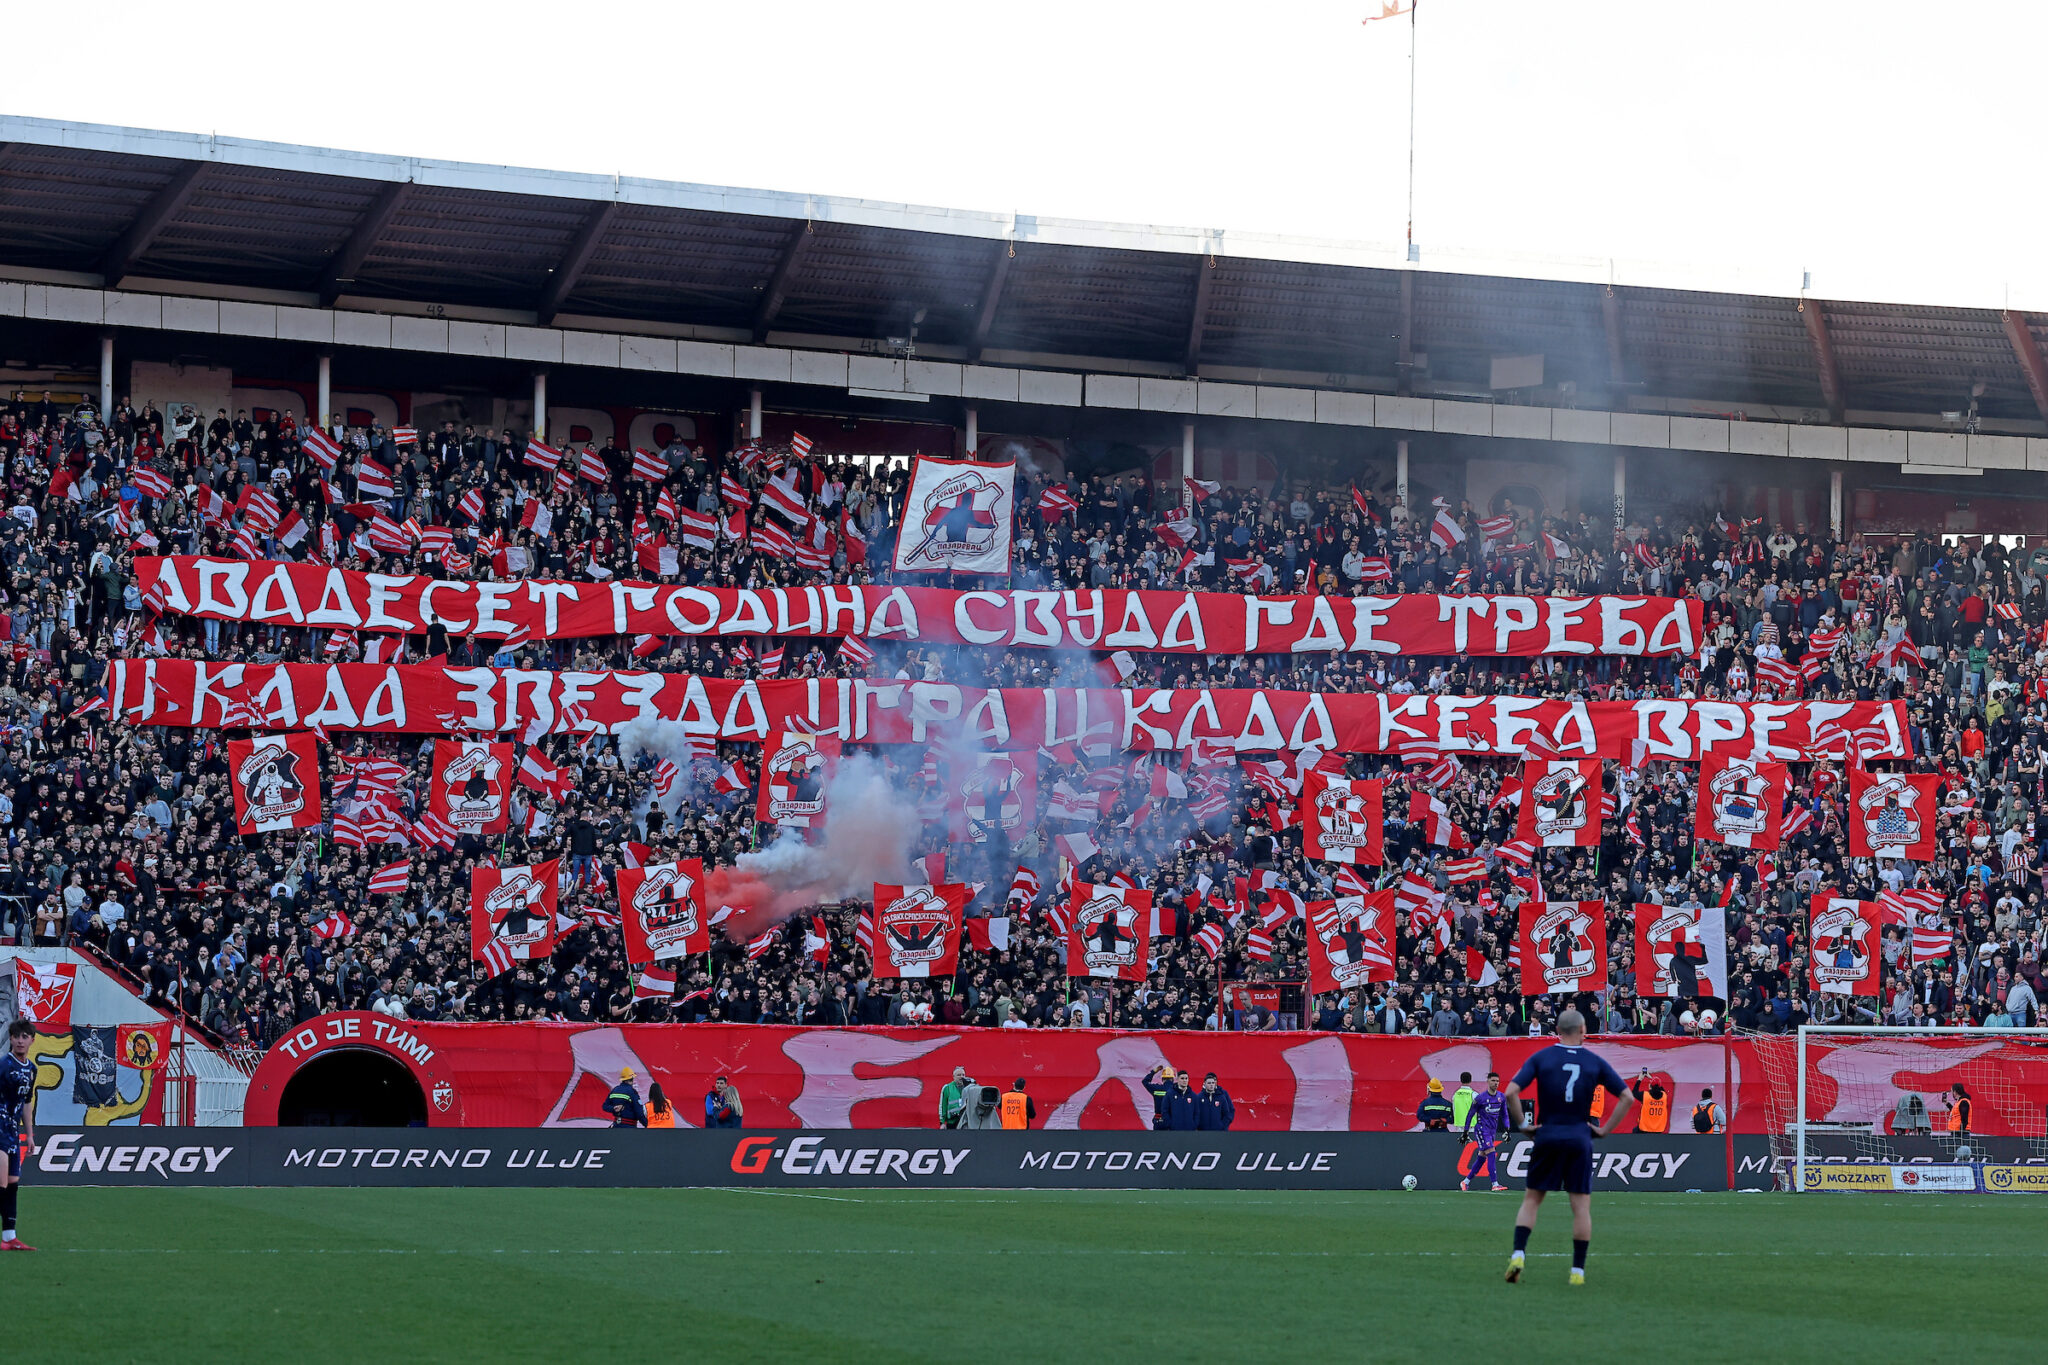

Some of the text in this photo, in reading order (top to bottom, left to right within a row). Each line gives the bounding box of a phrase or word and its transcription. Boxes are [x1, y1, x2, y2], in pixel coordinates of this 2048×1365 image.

[151, 556, 1695, 657] ДВАДЕСЕТ ГОДИНА СВУДА ГДЕ ТРЕБА
[111, 658, 157, 721] И
[190, 662, 407, 729] КАДА
[441, 665, 772, 740] ЗВЕЗДА
[805, 678, 1010, 748] ИГРА
[1043, 688, 1092, 748] И
[1121, 688, 1339, 752] КАДА
[279, 1018, 435, 1067] ТО ЈЕ ТИМ!
[1562, 1062, 1581, 1103] 7
[283, 1148, 611, 1169] MOTORNO ULJE
[1019, 1151, 1338, 1172] MOTORNO ULJE
[1826, 1173, 1887, 1184] MOZZART
